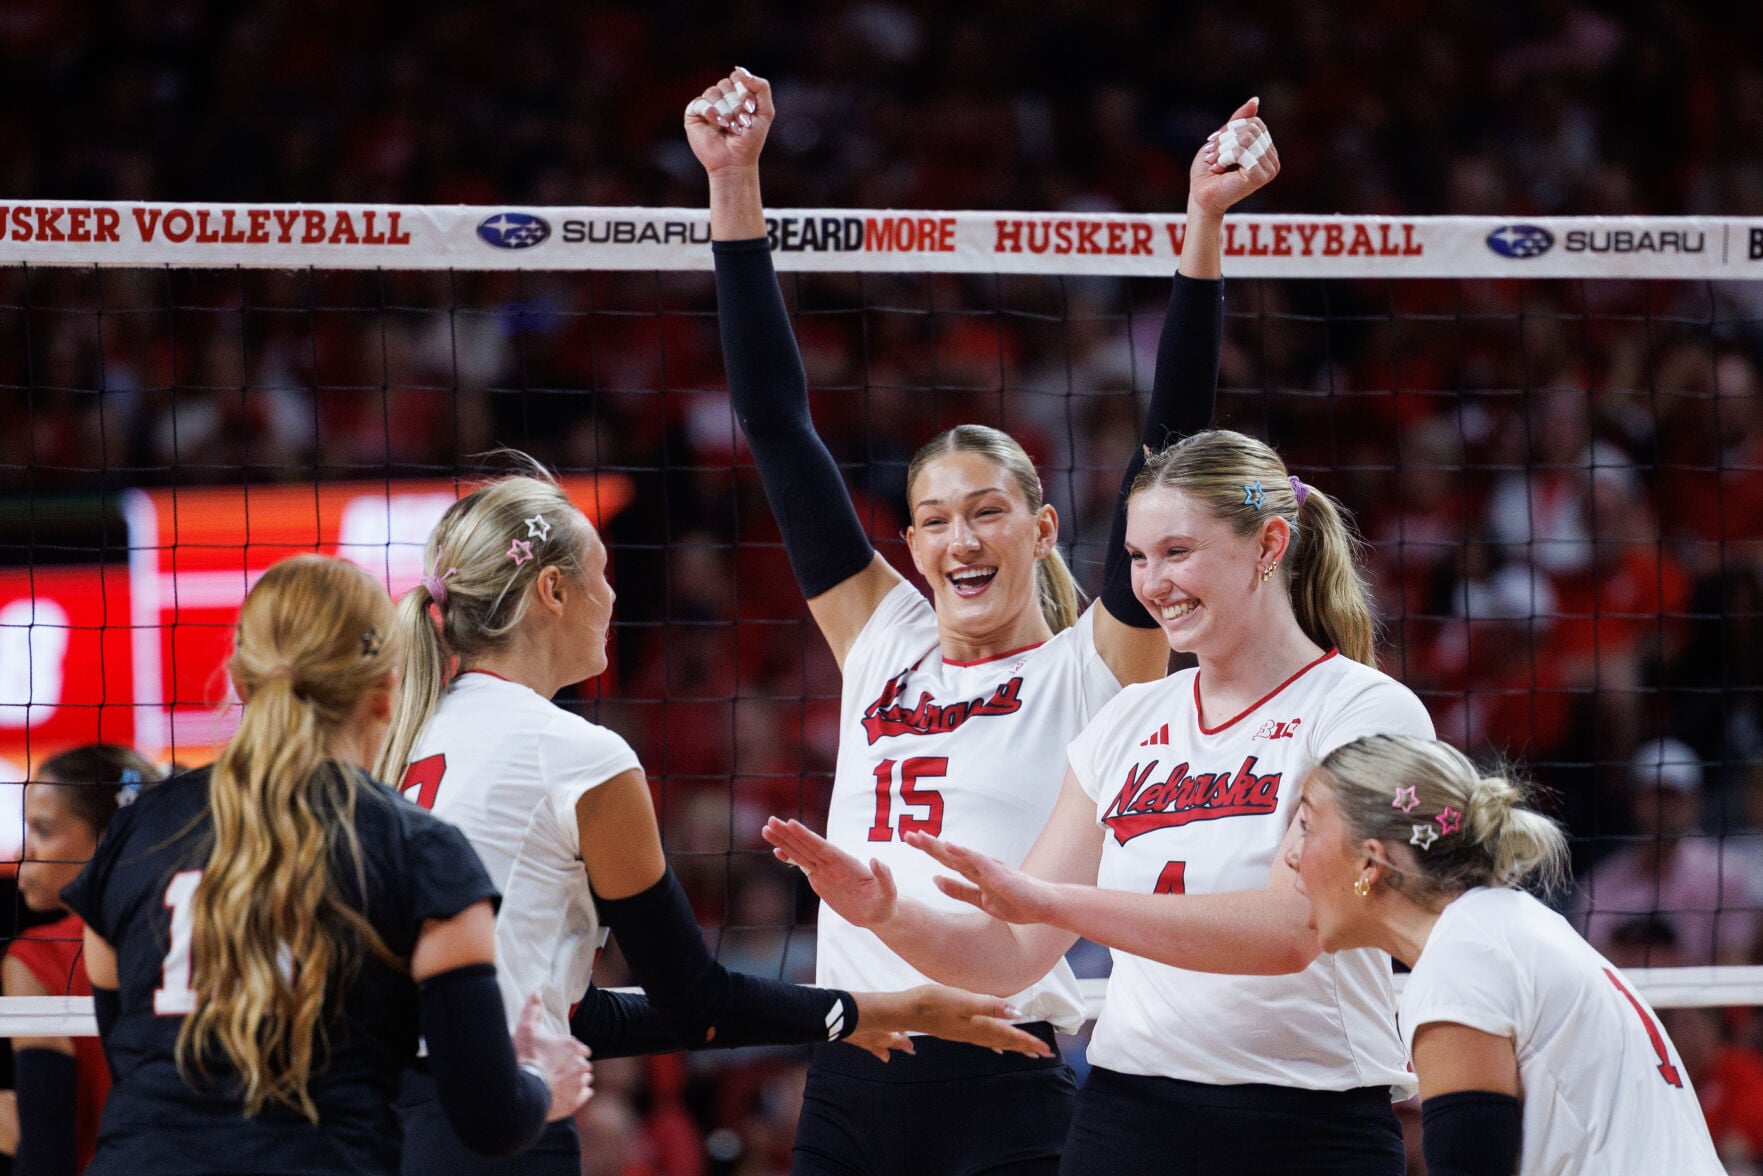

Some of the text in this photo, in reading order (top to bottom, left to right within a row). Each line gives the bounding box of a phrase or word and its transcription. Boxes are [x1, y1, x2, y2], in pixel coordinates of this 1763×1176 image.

[132, 207, 411, 245] VOLLEYBALL
[562, 220, 713, 245] SUBARU
[765, 217, 957, 252] BEARDMORE
[994, 220, 1423, 257] HUSKER VLLEYBALL
[1565, 230, 1705, 253] SUBARU
[867, 756, 949, 842] 15
[1102, 755, 1283, 822] Nebraska
